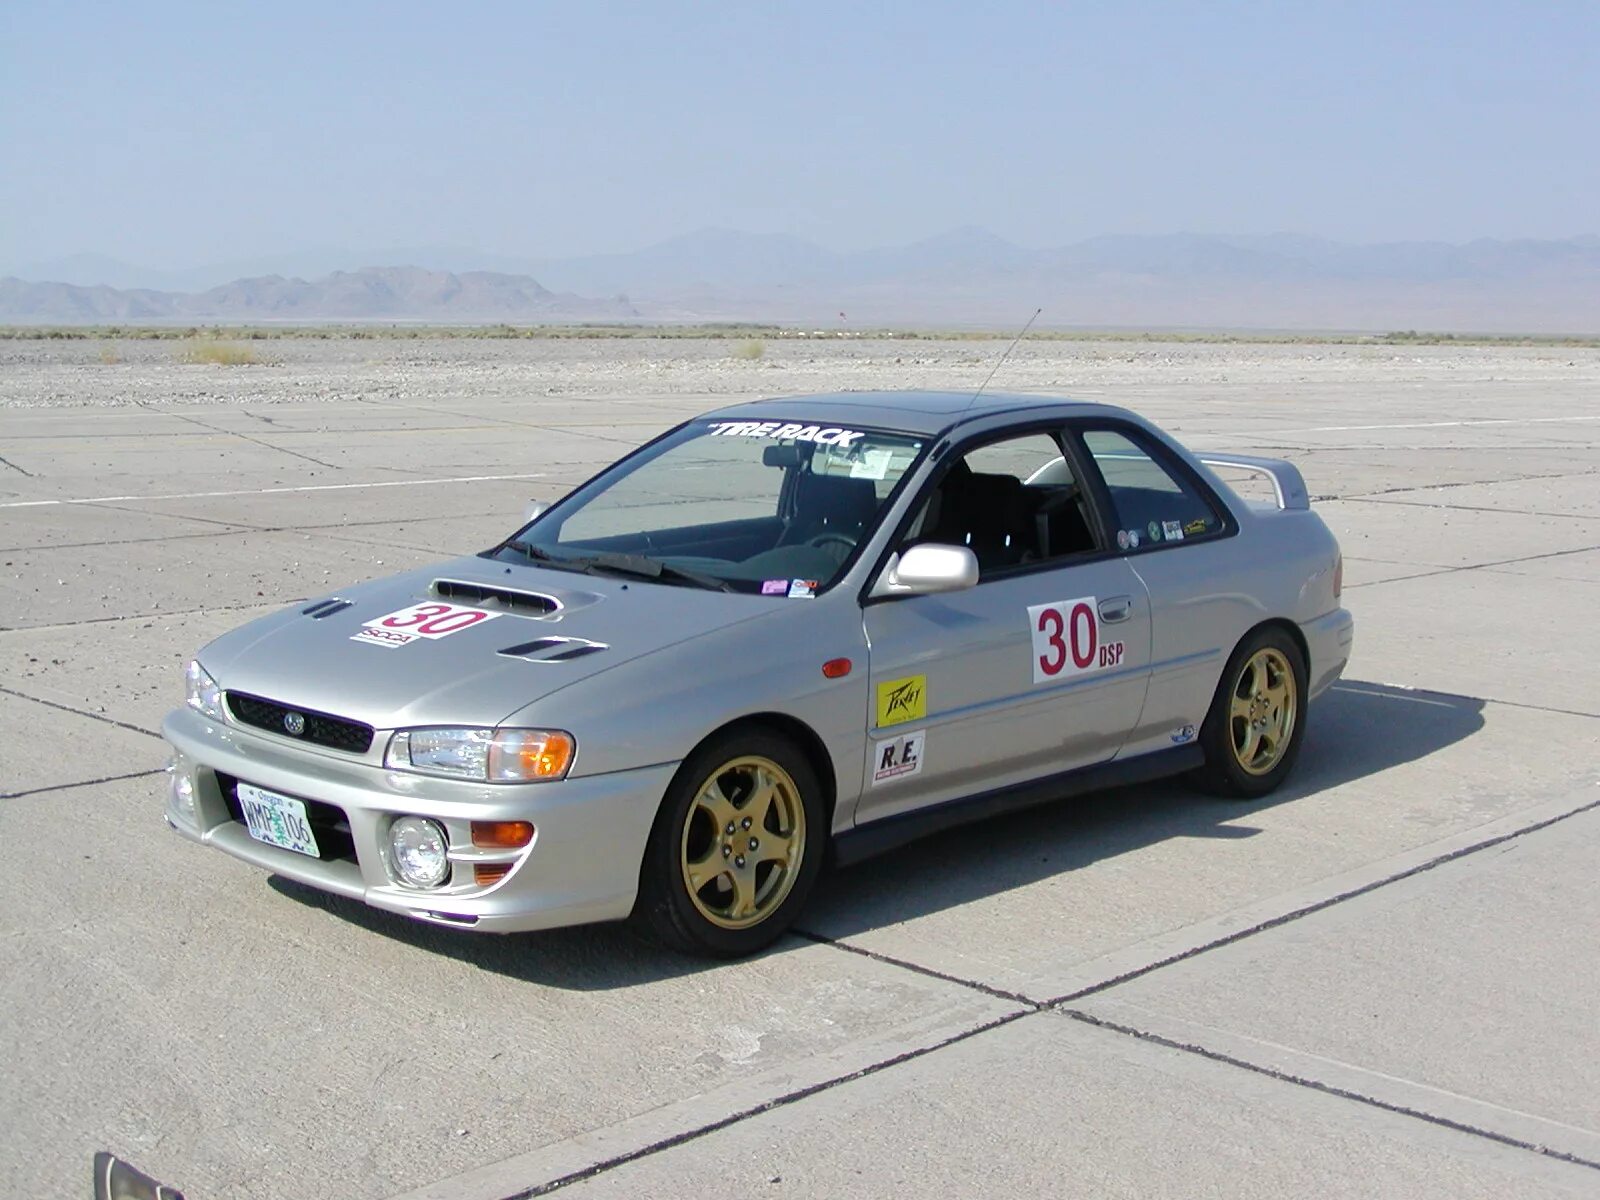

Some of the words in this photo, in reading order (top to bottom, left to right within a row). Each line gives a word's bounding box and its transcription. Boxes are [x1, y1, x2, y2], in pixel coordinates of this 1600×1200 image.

[708, 421, 774, 438] TIRE
[769, 424, 865, 447] RACK
[382, 605, 488, 634] 30
[1038, 603, 1097, 676] 30
[1099, 642, 1123, 667] DSP
[242, 799, 272, 832] WMP
[280, 811, 310, 844] 106
